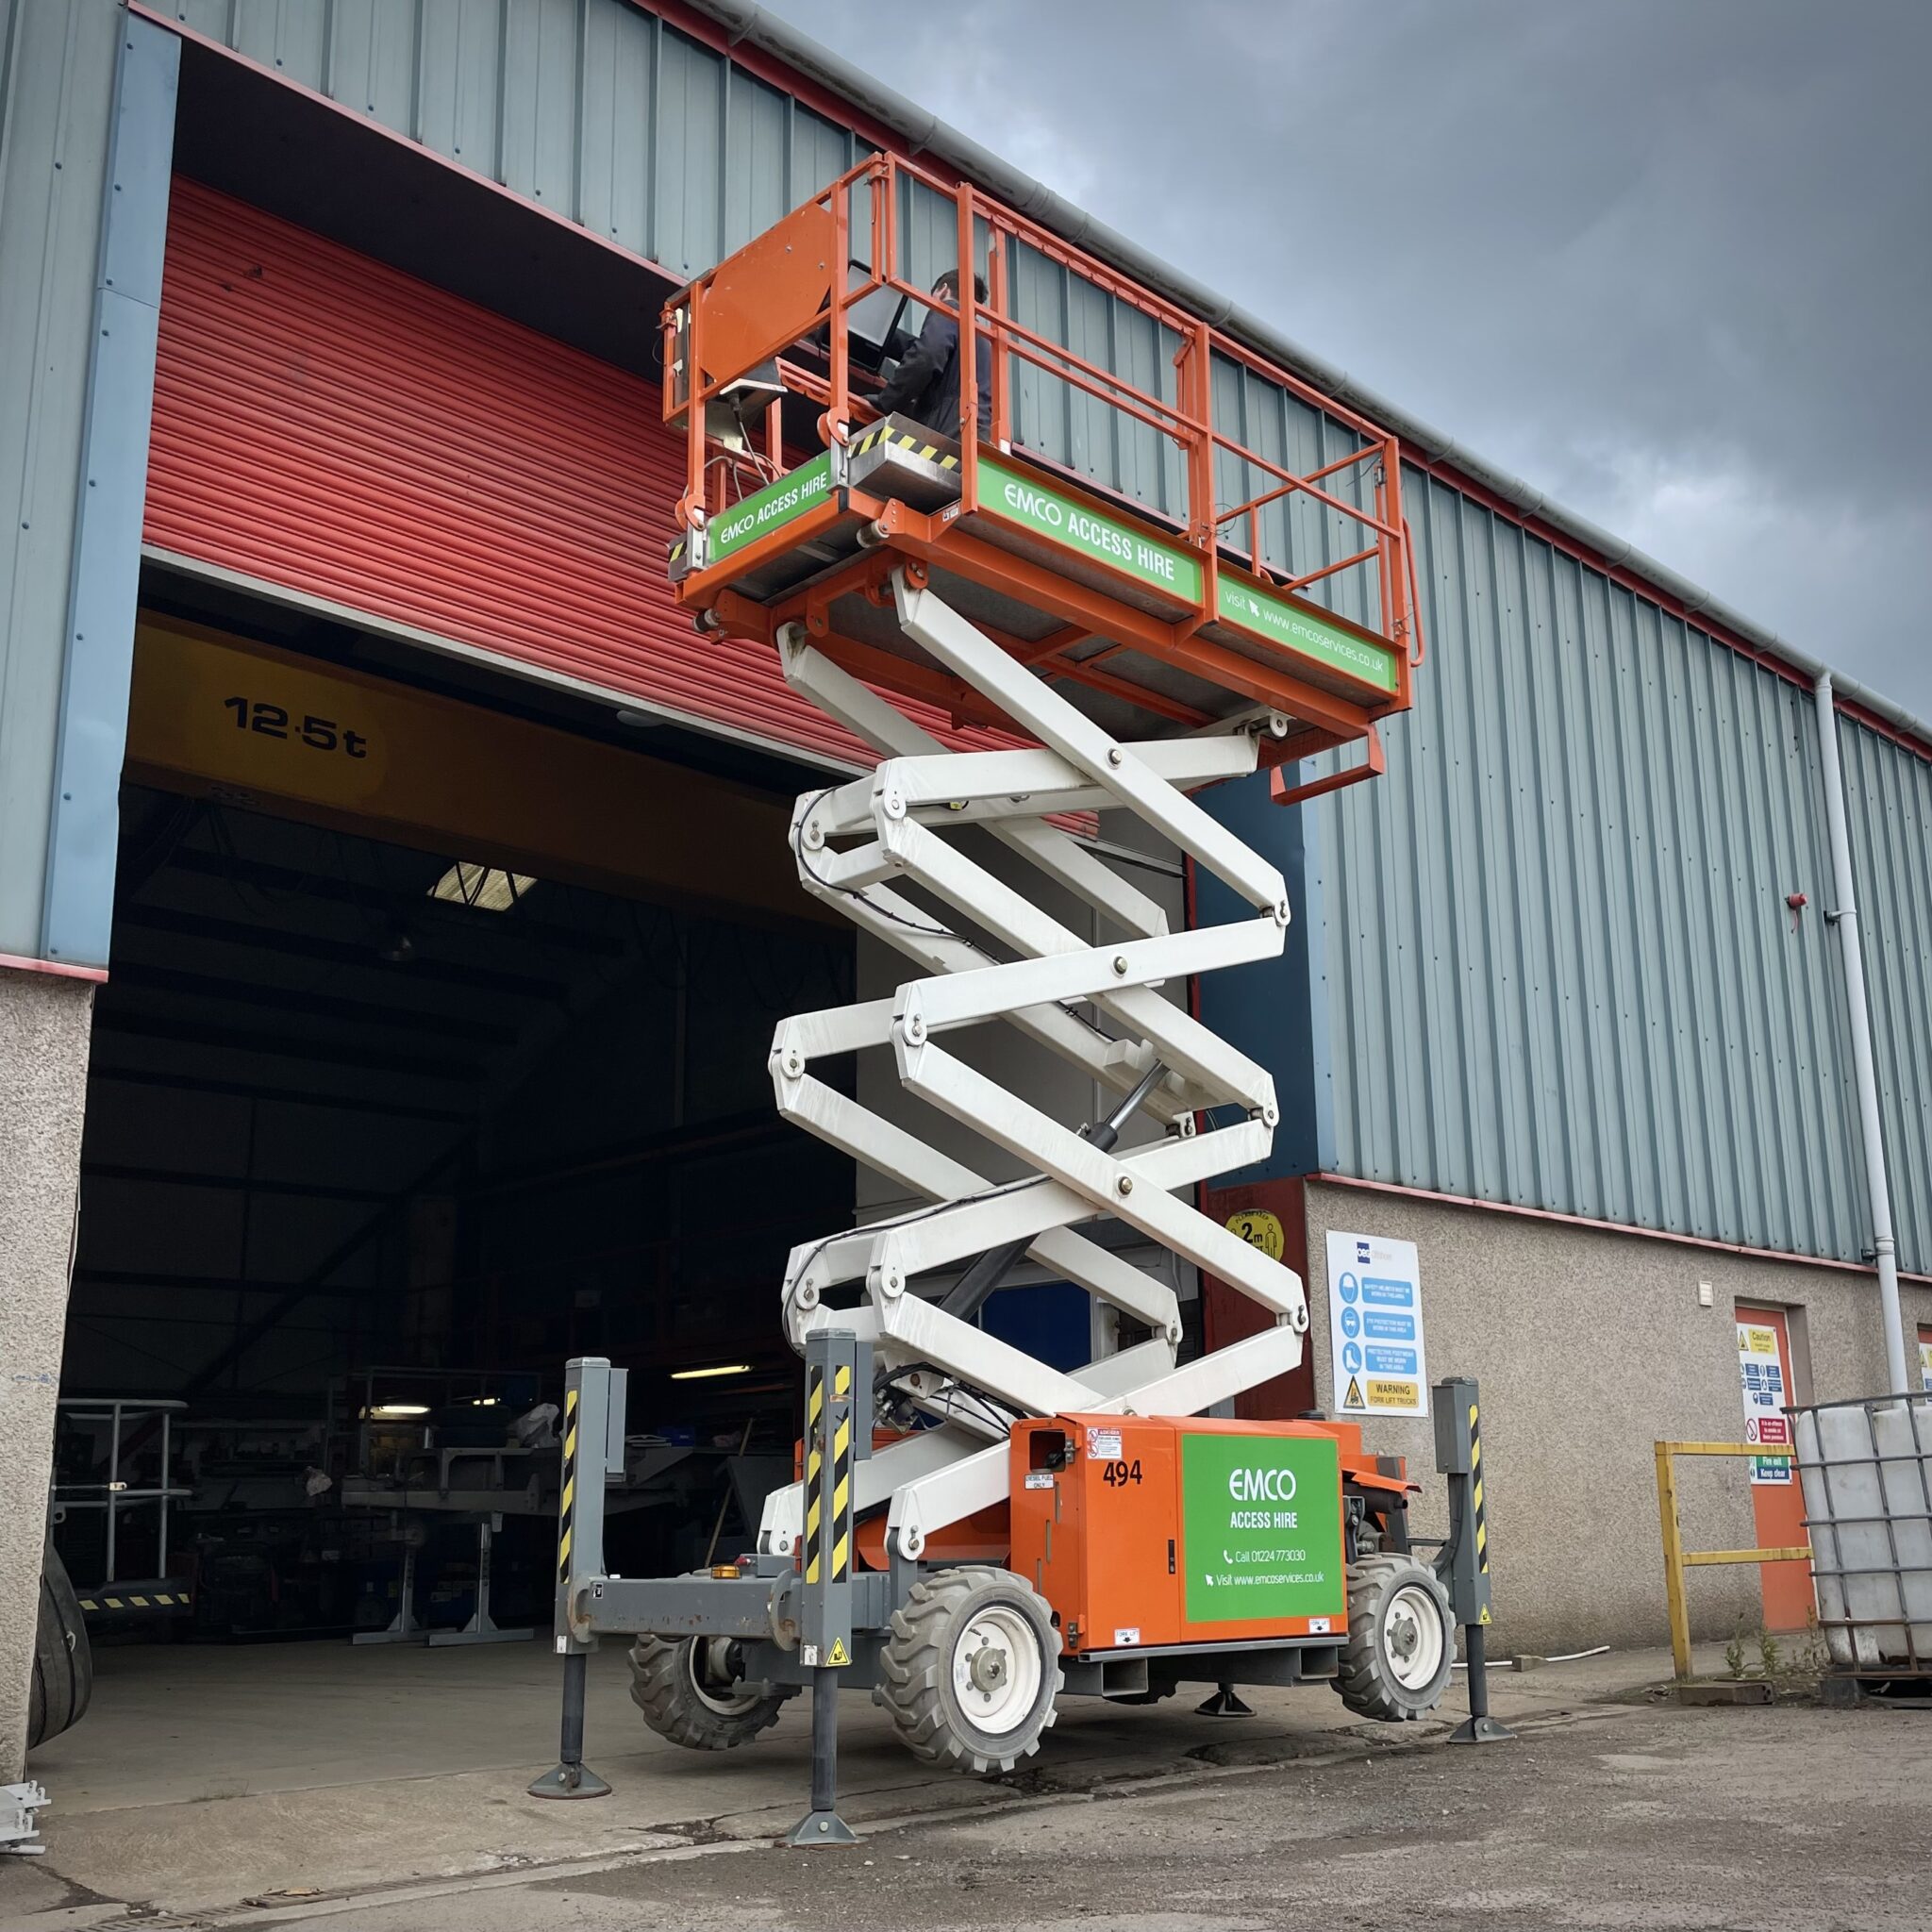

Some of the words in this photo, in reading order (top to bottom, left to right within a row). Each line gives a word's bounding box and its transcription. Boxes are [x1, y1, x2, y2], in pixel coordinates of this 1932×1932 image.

[720, 513, 755, 544] EMCO
[757, 489, 798, 525] ACCESS
[801, 472, 827, 500] HIRE
[1004, 483, 1062, 526] EMCO
[1068, 512, 1132, 561] ACCESS
[1138, 544, 1175, 581] HIRE
[1224, 591, 1246, 611] visit
[1262, 608, 1384, 673] www.emcoservices.co.uk
[1241, 1222, 1263, 1243] 2m
[1752, 1331, 1772, 1342] Caution
[1375, 1384, 1410, 1395] WARNING
[1397, 1397, 1417, 1406] TRUCKS
[1103, 1459, 1143, 1488] 494
[1760, 1468, 1774, 1479] Keep
[1774, 1468, 1786, 1477] clear
[1228, 1468, 1297, 1502] EMCO
[1229, 1511, 1271, 1529] ACCESS
[1274, 1511, 1298, 1529] HIRE
[1235, 1550, 1250, 1563] Call
[1251, 1550, 1274, 1562] 01224
[1275, 1549, 1306, 1561] 773030
[1216, 1574, 1233, 1586] Visit
[1234, 1571, 1324, 1586] www.emcoservices.co.uk
